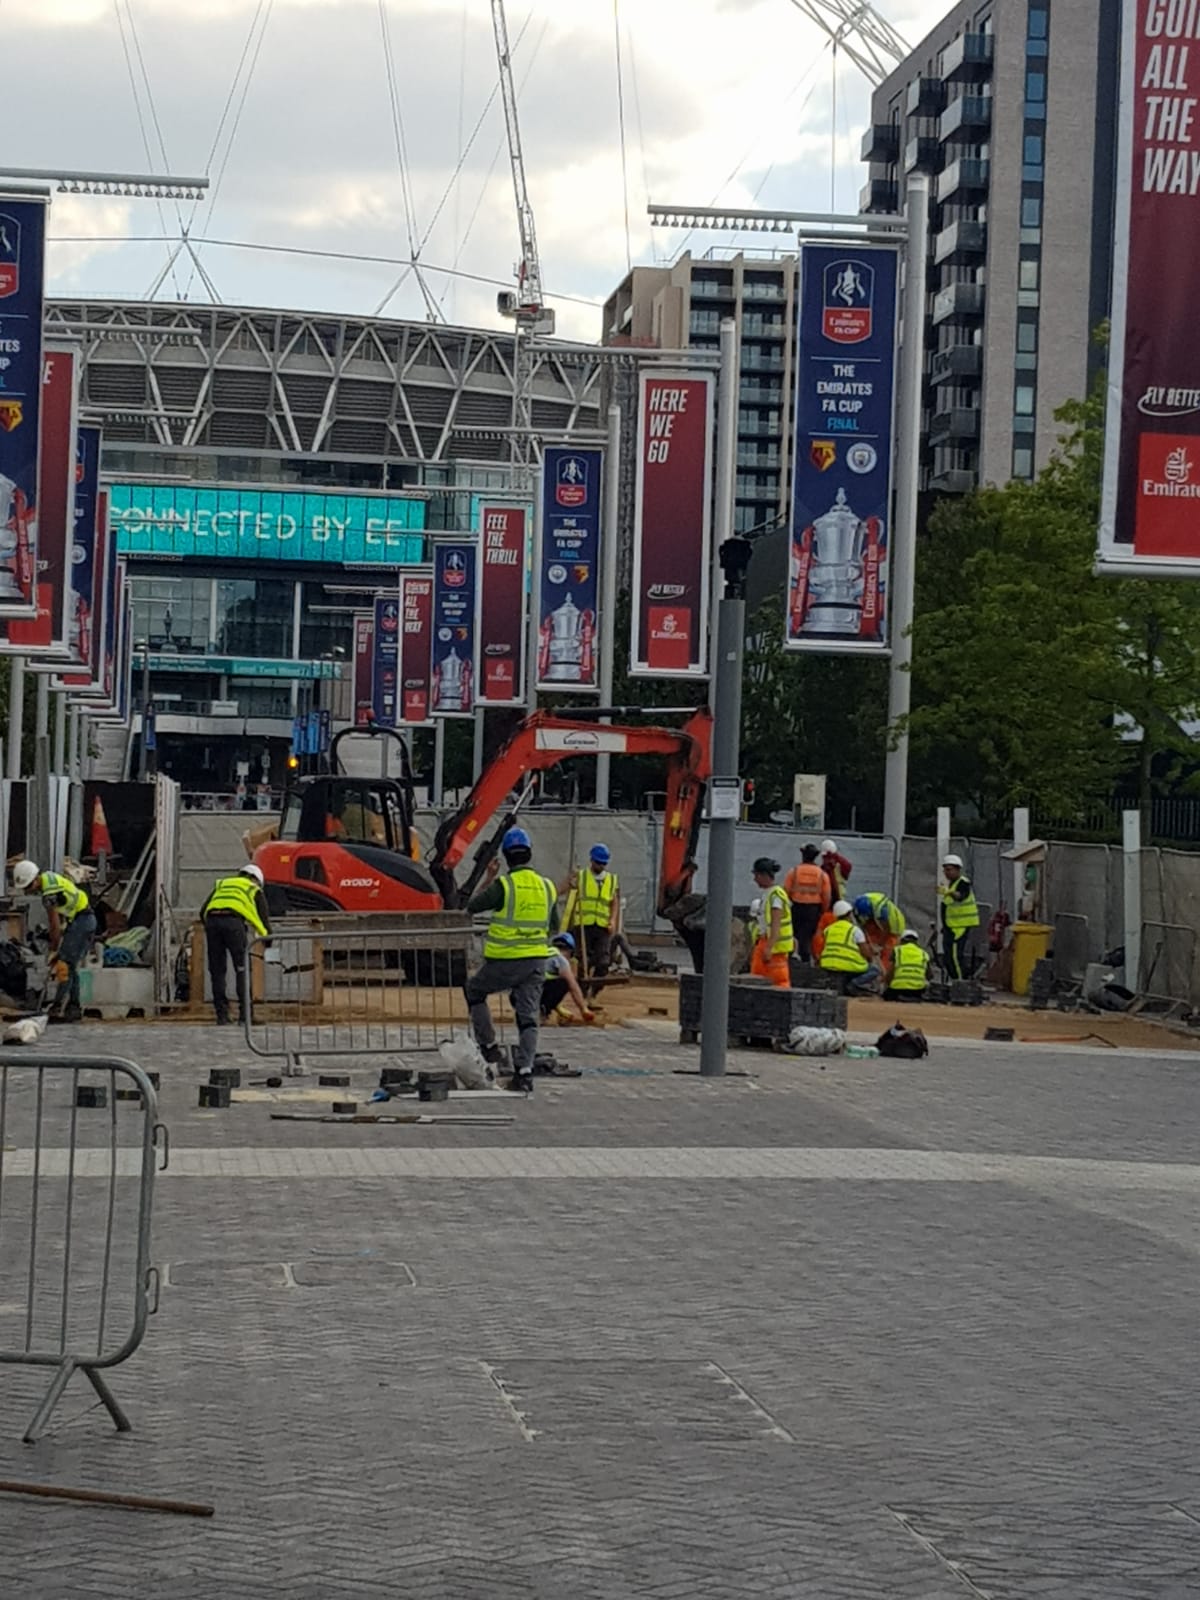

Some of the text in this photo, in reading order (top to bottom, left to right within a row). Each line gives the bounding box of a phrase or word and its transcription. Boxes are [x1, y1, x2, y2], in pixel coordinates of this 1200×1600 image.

[1142, 44, 1189, 90] ALL
[1144, 96, 1198, 142] THE
[1143, 148, 1200, 195] WAY
[832, 364, 855, 377] THE
[817, 381, 872, 395] EMIRATES
[1144, 386, 1200, 407] FLY BETTE
[649, 388, 688, 412] HERE
[822, 399, 863, 413] FA CUP
[649, 414, 675, 437] WE
[827, 417, 859, 430] FINAL
[647, 440, 669, 463] GO
[312, 515, 351, 542] BY
[366, 518, 403, 546] EE
